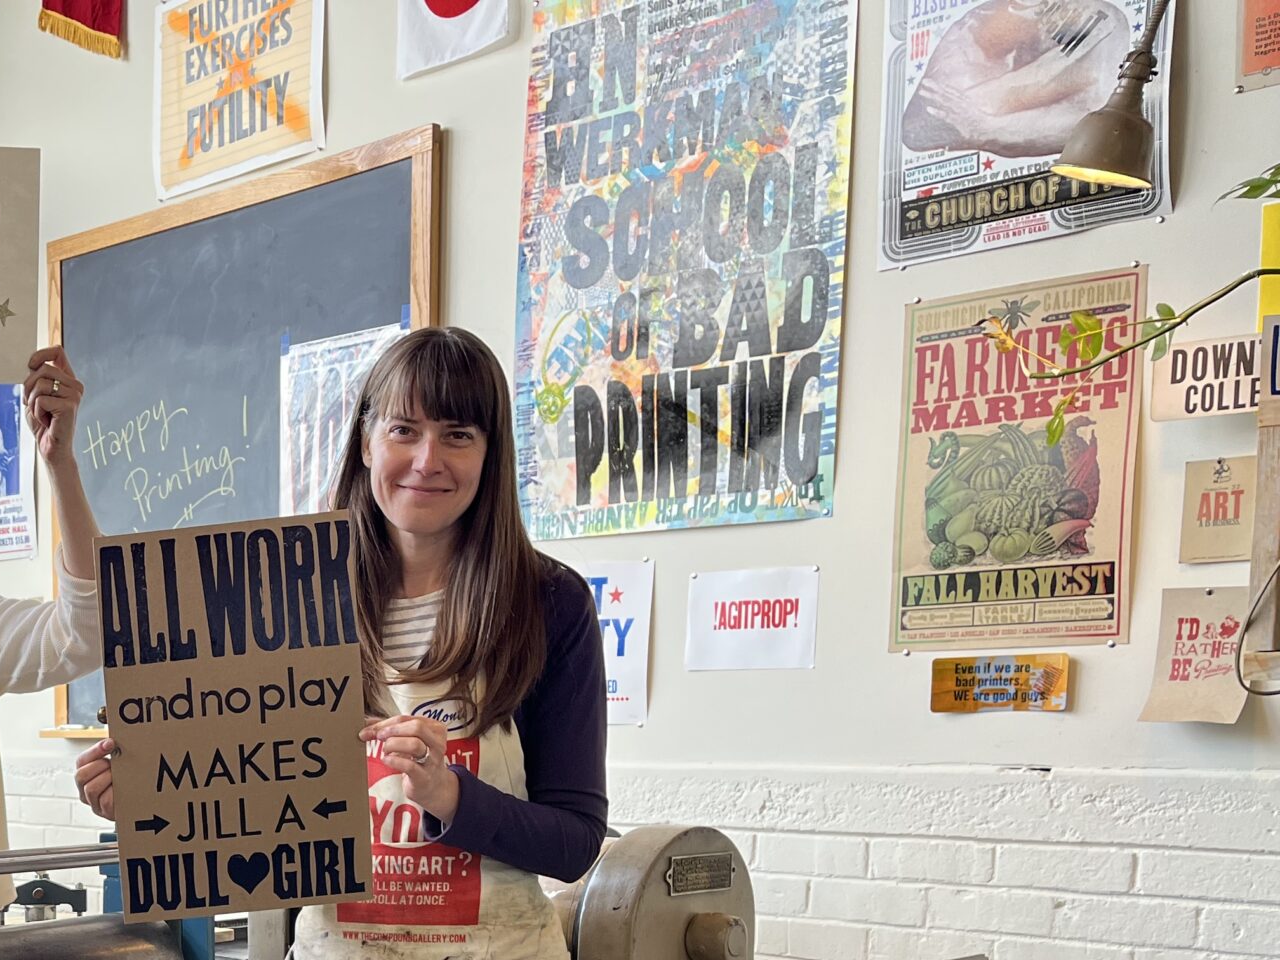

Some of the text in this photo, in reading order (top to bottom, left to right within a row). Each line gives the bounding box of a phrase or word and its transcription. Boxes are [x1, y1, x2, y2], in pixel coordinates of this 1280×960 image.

[185, 7, 293, 84] EXERCISES
[187, 71, 290, 158] FUTILITY
[906, 157, 973, 178] OFTEN IMITATED
[923, 164, 975, 182] DUPLICATED
[1003, 166, 1026, 179] ART
[562, 142, 819, 289] SCHOOL
[924, 181, 1026, 229] CHURCH
[1029, 174, 1061, 206] OF
[983, 233, 1001, 243] LEAD
[673, 248, 830, 369] BAD
[911, 381, 1127, 434] MARKET
[83, 400, 189, 470] Happy
[573, 352, 822, 506] PRINTING
[1197, 489, 1245, 523] ART
[12, 525, 27, 534] HALL
[100, 520, 360, 668] ALL WORK
[907, 563, 1112, 605] FALL HARVEST
[713, 598, 800, 631] !AGITPROP!
[1176, 617, 1200, 641] I'D
[1173, 640, 1239, 658] RATHER
[955, 662, 1031, 674] Even if we are
[955, 676, 975, 687] bad
[1168, 658, 1192, 681] BE
[119, 666, 350, 724] and no play
[954, 690, 969, 701] WE
[973, 691, 990, 701] are
[993, 689, 1018, 703] good
[156, 737, 328, 793] MAKES
[177, 793, 306, 842] JILL A
[126, 837, 366, 914] DULL GIRL
[390, 881, 453, 892] BE WANTED.
[399, 894, 414, 905] AT
